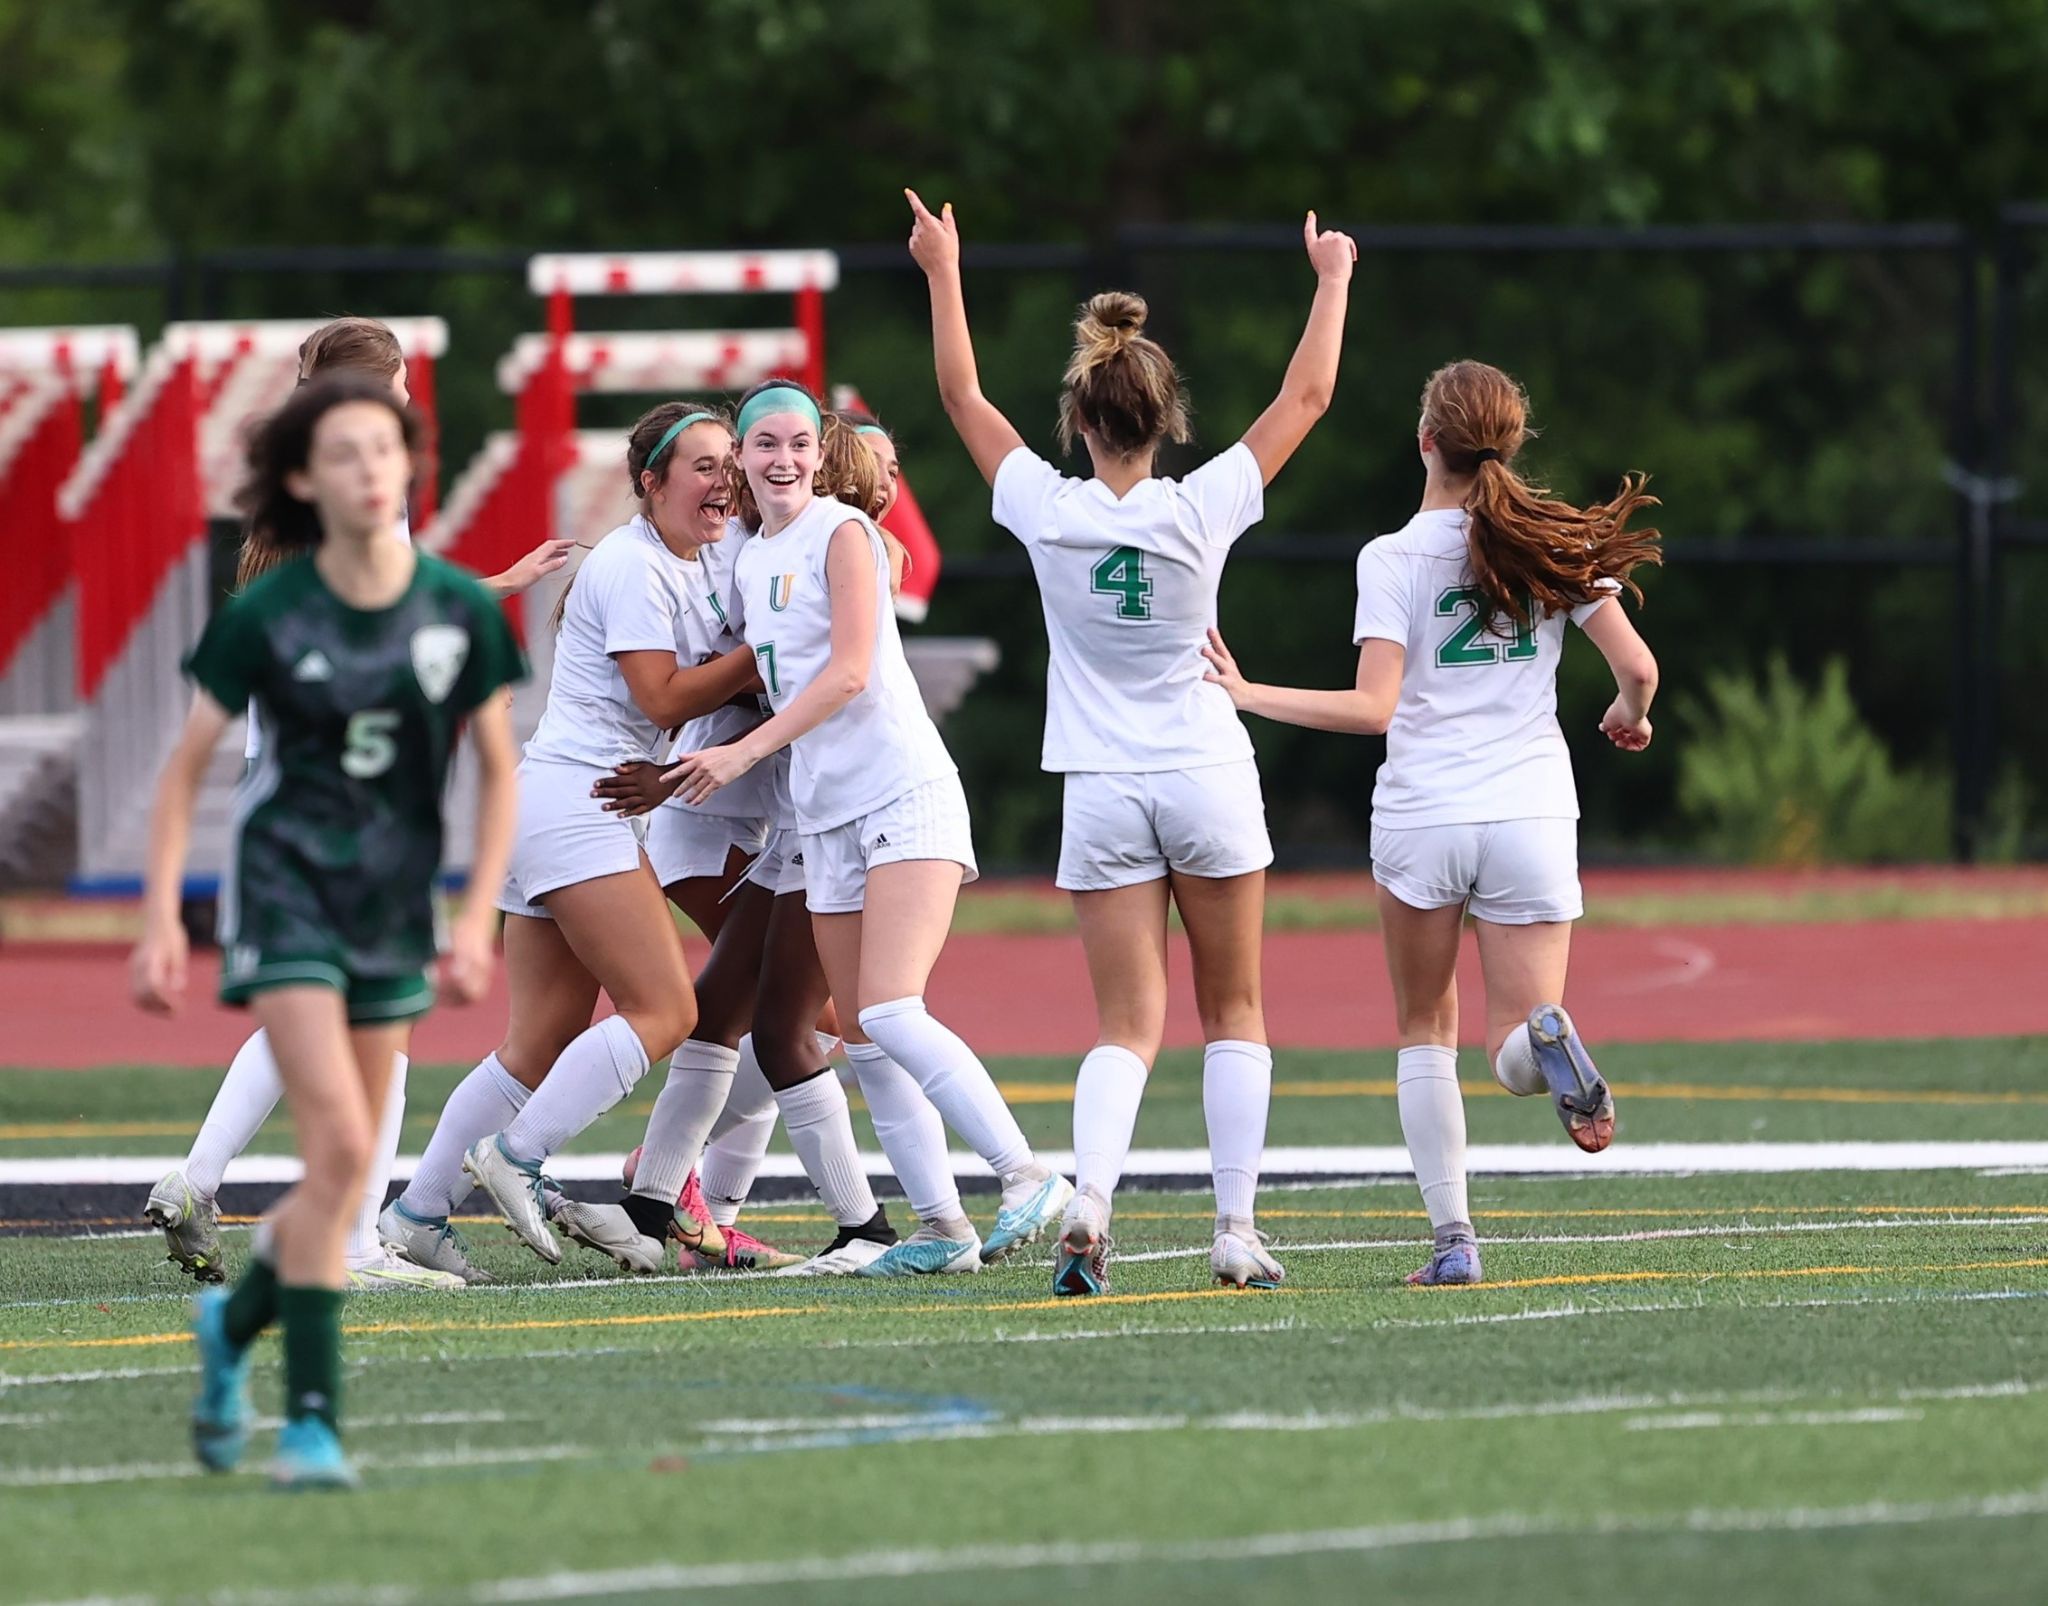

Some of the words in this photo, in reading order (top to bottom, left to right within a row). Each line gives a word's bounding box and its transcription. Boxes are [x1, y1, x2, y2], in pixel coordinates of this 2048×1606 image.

[770, 574, 796, 612] U
[1090, 545, 1153, 620] 4
[340, 709, 402, 779] 5
